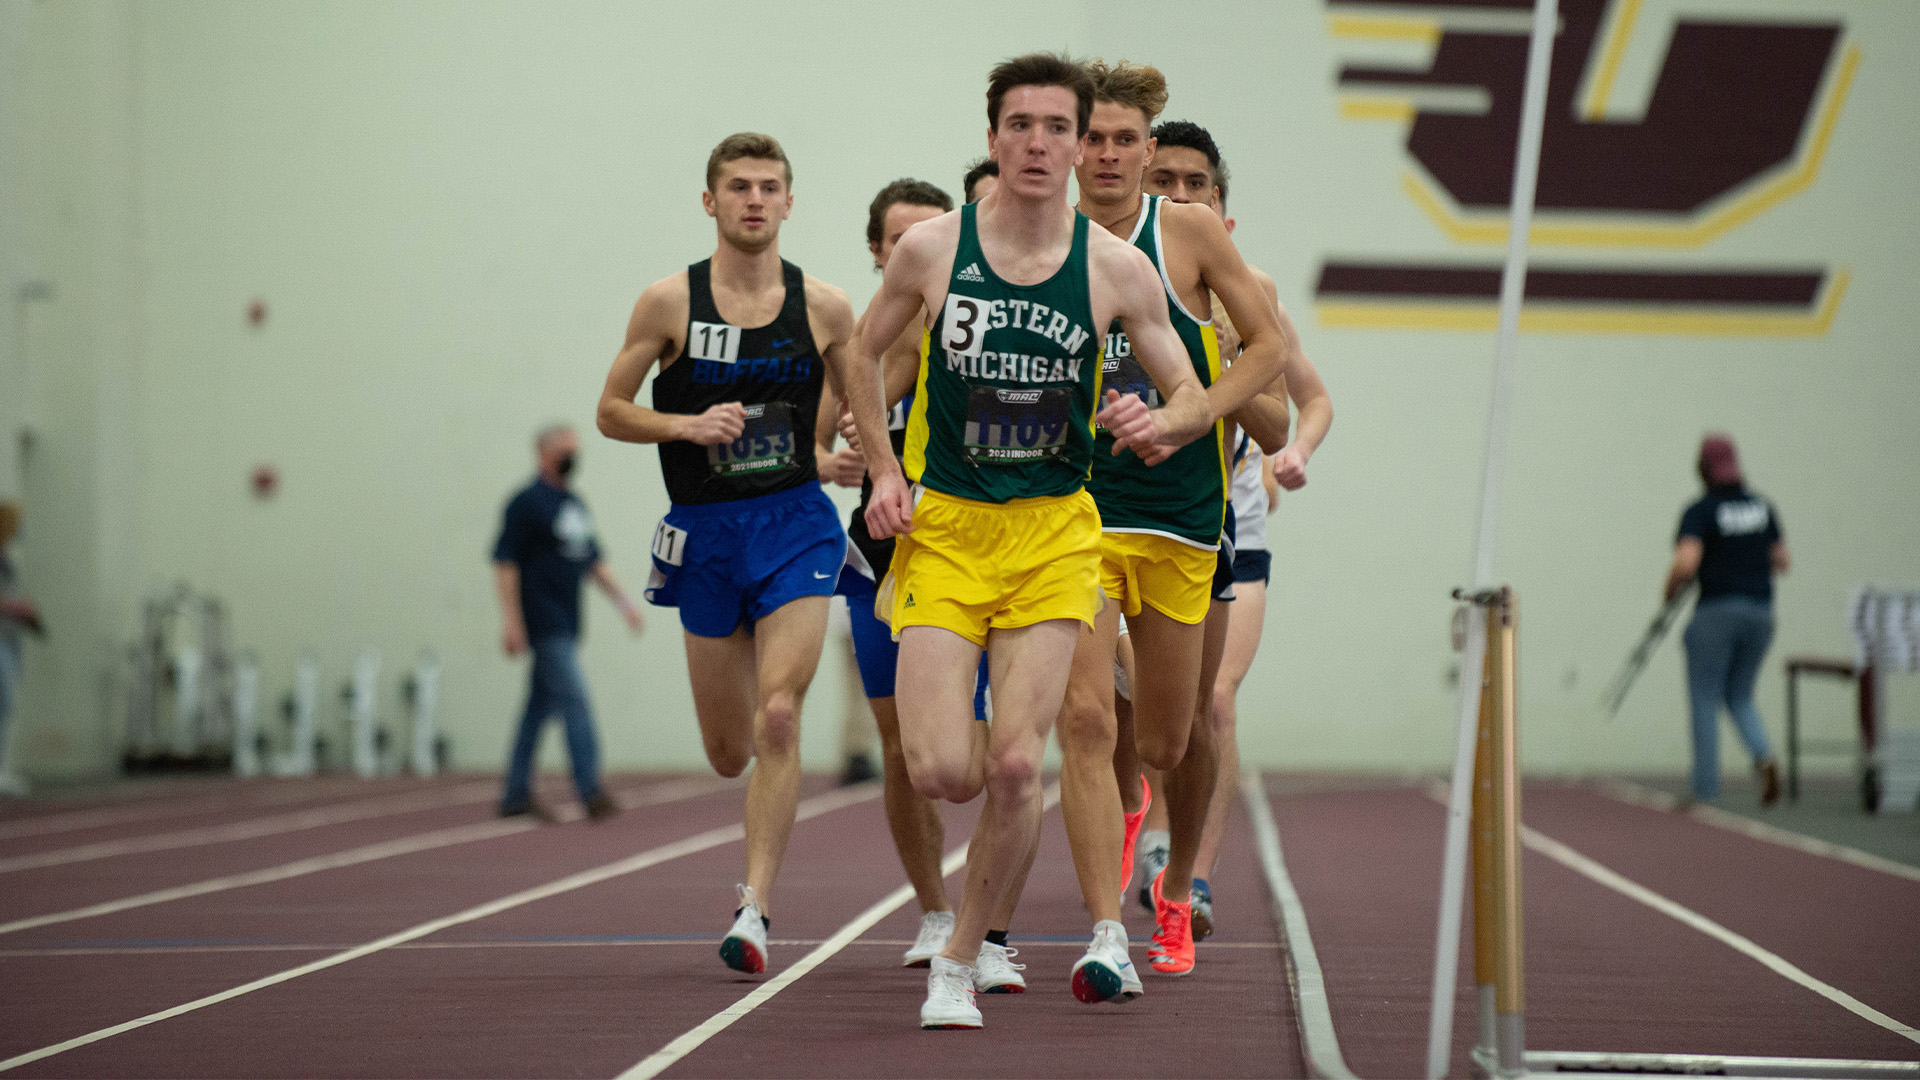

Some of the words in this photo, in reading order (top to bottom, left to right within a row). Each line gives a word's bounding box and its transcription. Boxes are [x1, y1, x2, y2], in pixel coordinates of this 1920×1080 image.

[957, 272, 985, 282] adidas
[949, 300, 979, 351] 3
[987, 299, 1090, 355] STERN
[700, 326, 729, 359] 11
[692, 358, 812, 384] BUFFALO
[946, 350, 1084, 383] MICHIGAN
[1008, 393, 1039, 401] MAC
[977, 411, 1064, 447] 1109
[657, 524, 676, 561] 11
